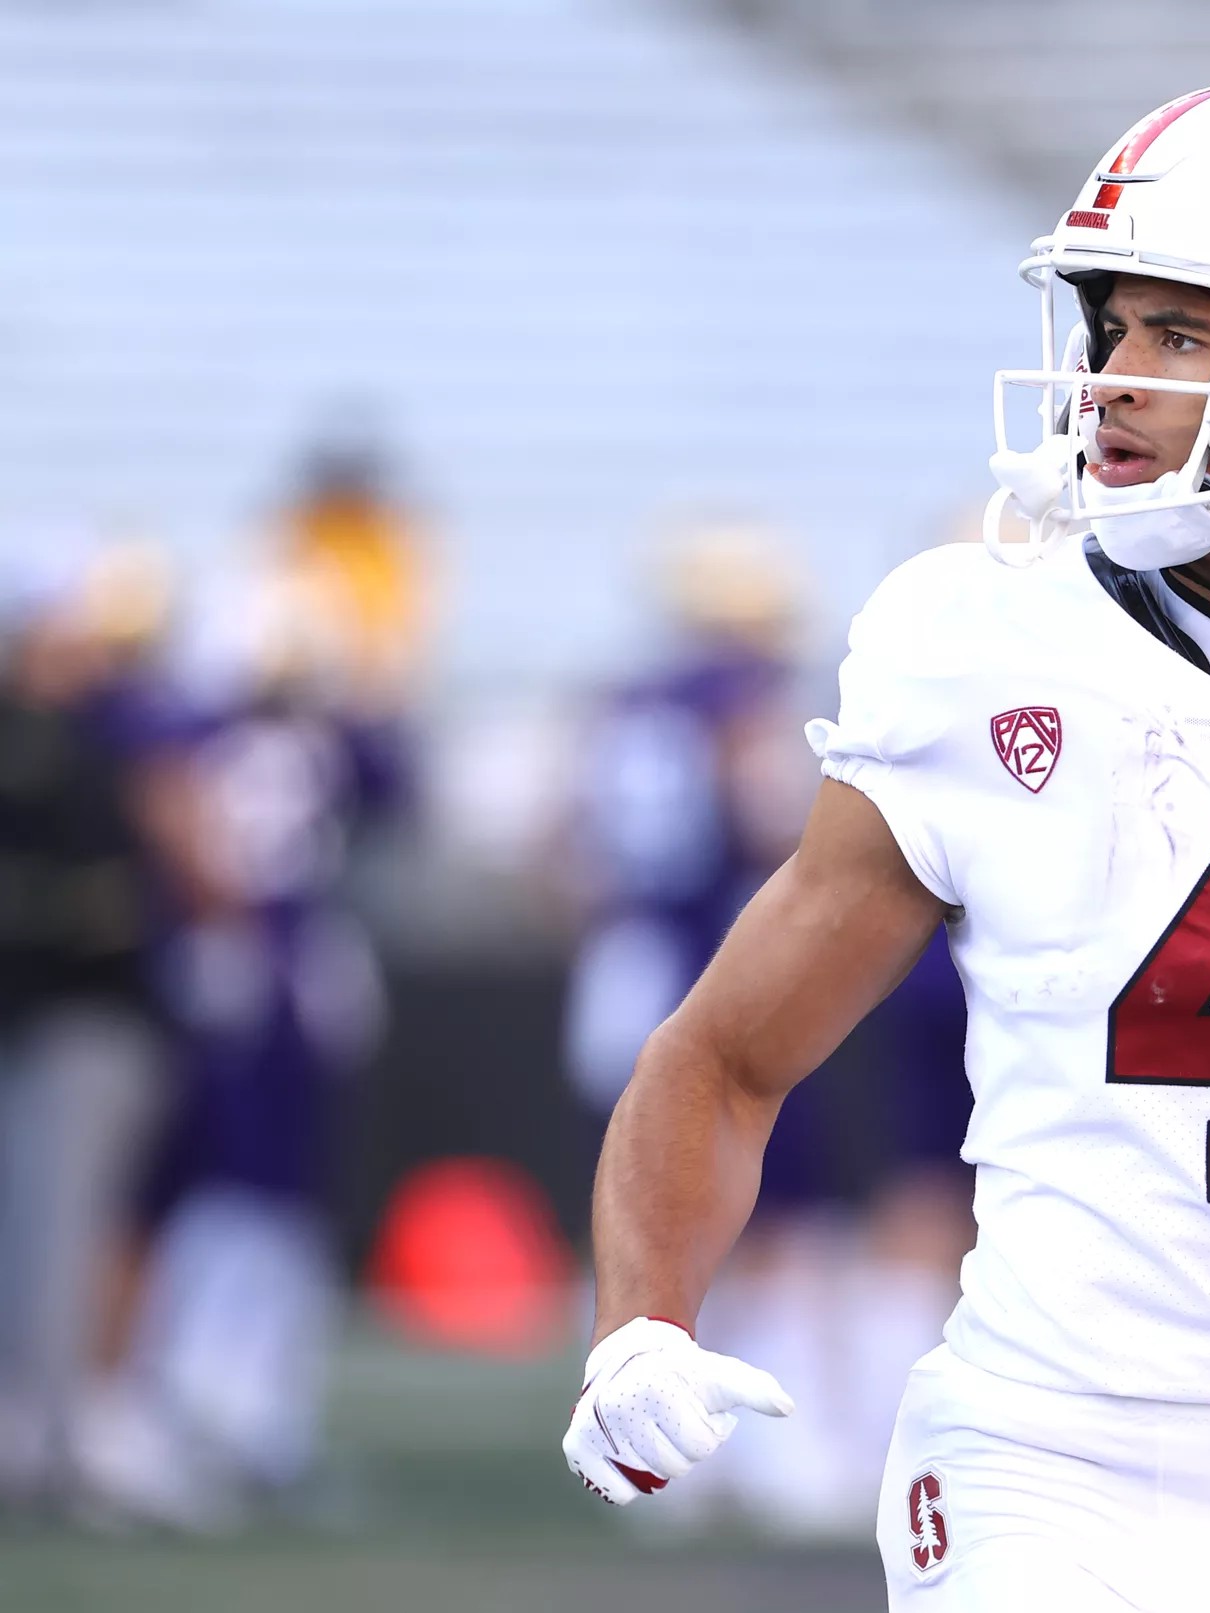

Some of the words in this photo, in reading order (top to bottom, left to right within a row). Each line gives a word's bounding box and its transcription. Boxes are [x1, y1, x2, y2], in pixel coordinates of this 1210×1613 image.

[1066, 211, 1110, 230] CARDINAL
[995, 711, 1056, 762] PAC
[1014, 743, 1047, 775] 12
